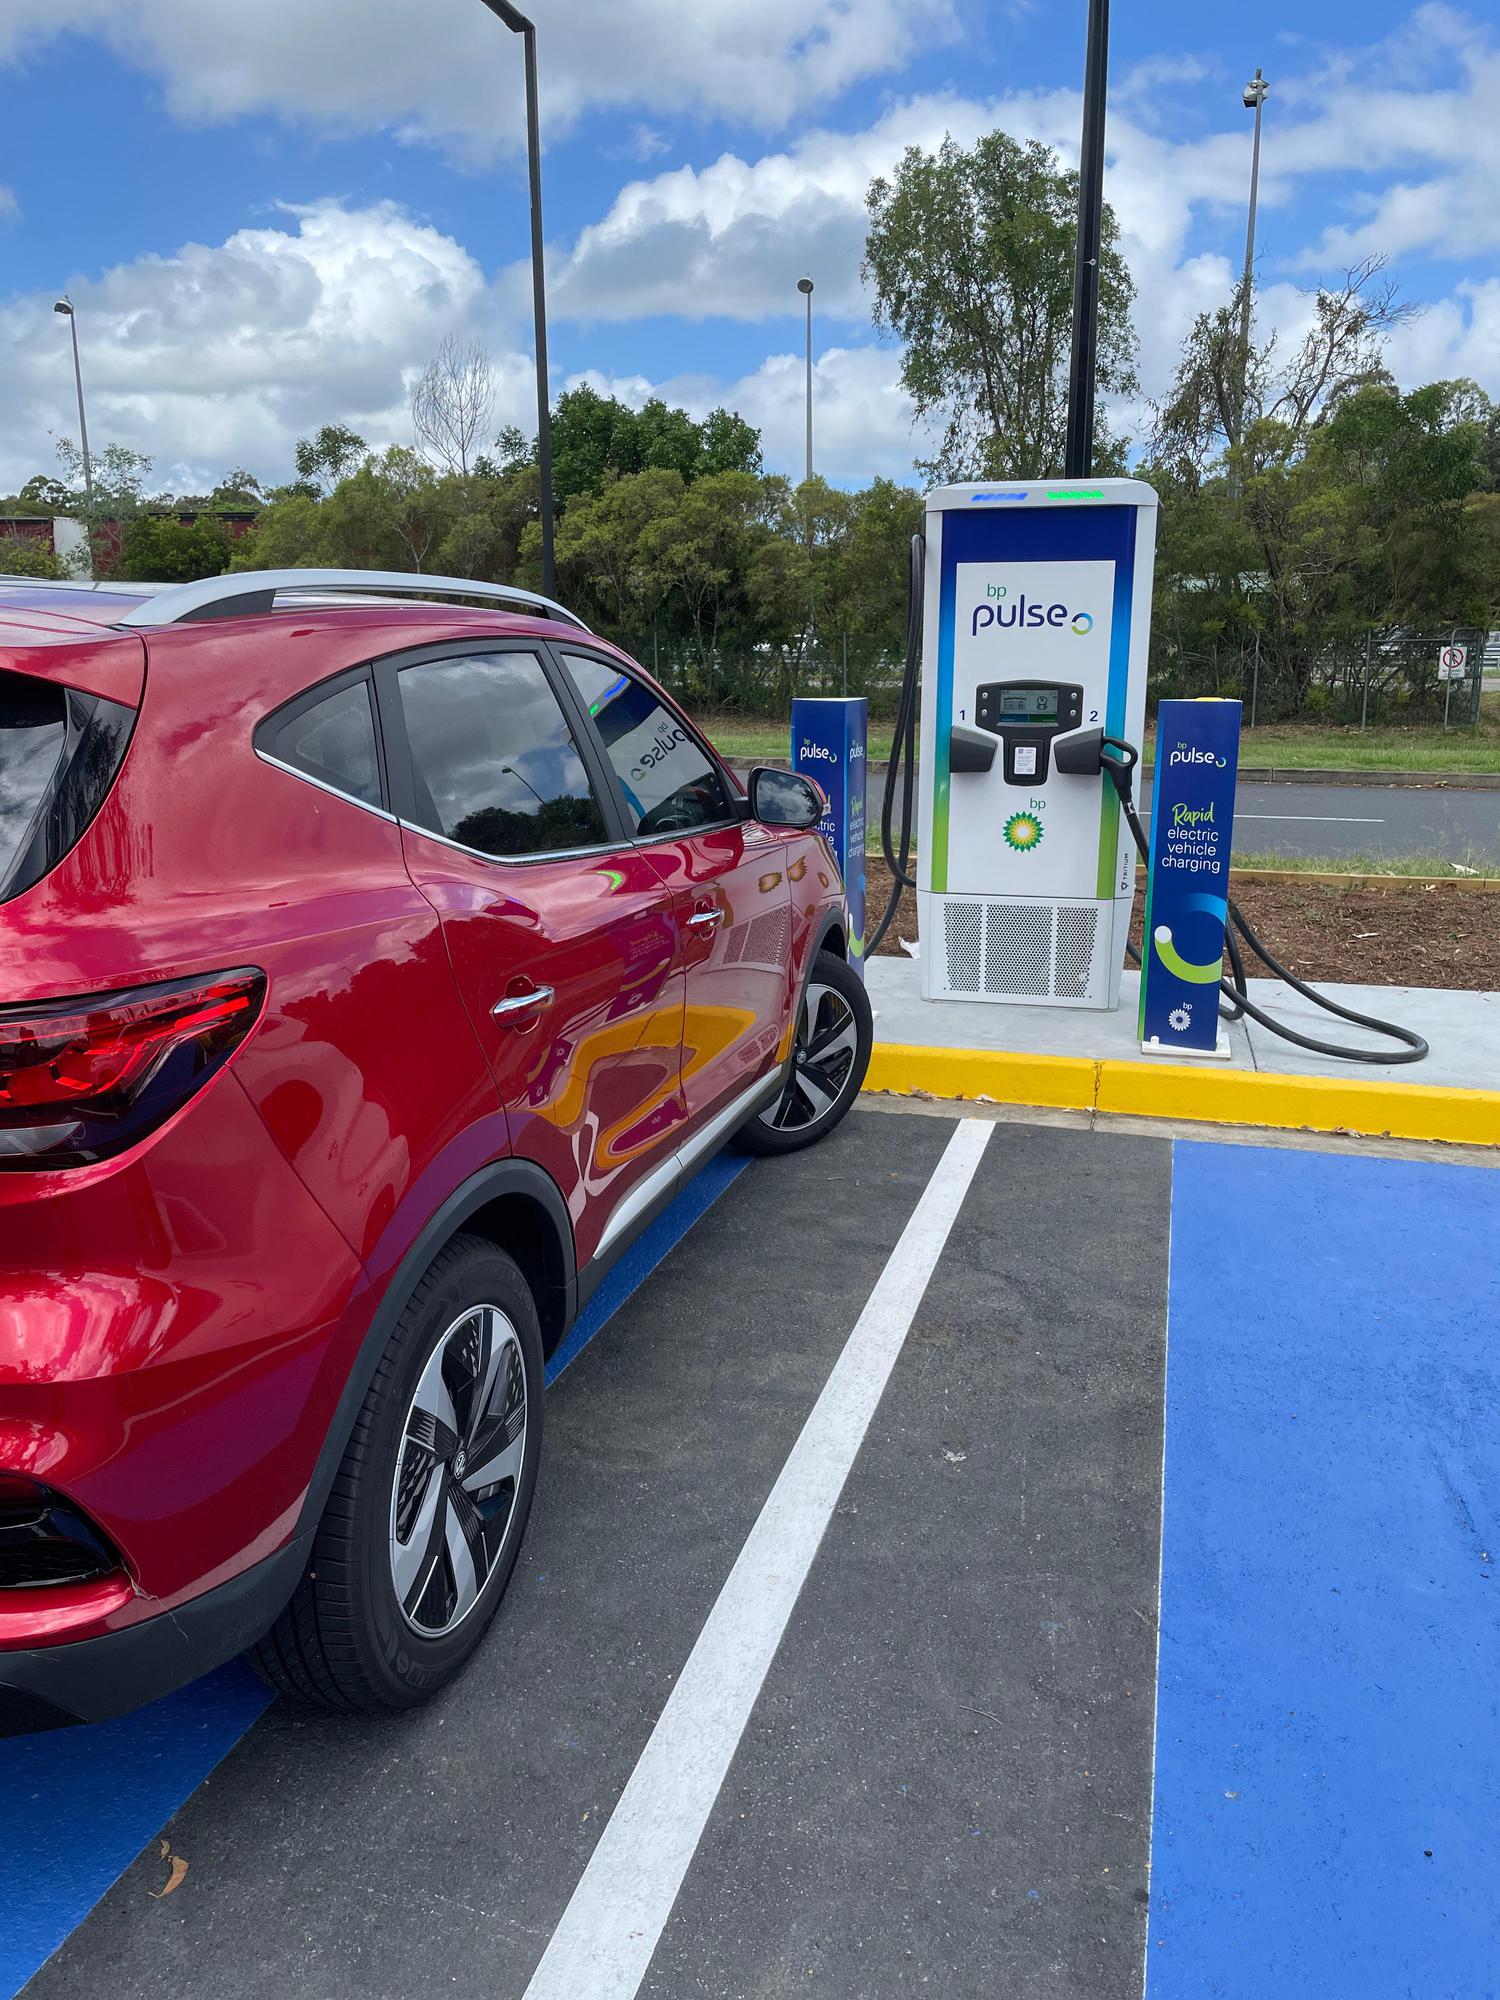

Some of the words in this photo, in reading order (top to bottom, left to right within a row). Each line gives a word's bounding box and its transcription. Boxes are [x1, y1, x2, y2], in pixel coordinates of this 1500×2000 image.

[987, 583, 1007, 600] bp
[972, 594, 1068, 636] pulse
[959, 709, 966, 721] 1
[1089, 710, 1098, 722] 2
[800, 743, 829, 760] pulse
[1177, 741, 1187, 750] bp
[1169, 747, 1215, 766] pulse
[1030, 798, 1046, 811] bp
[1172, 801, 1215, 827] Rapid
[1167, 826, 1219, 842] electric
[1167, 841, 1217, 857] vehicle
[1161, 854, 1221, 874] charging
[1182, 1002, 1193, 1011] bp
